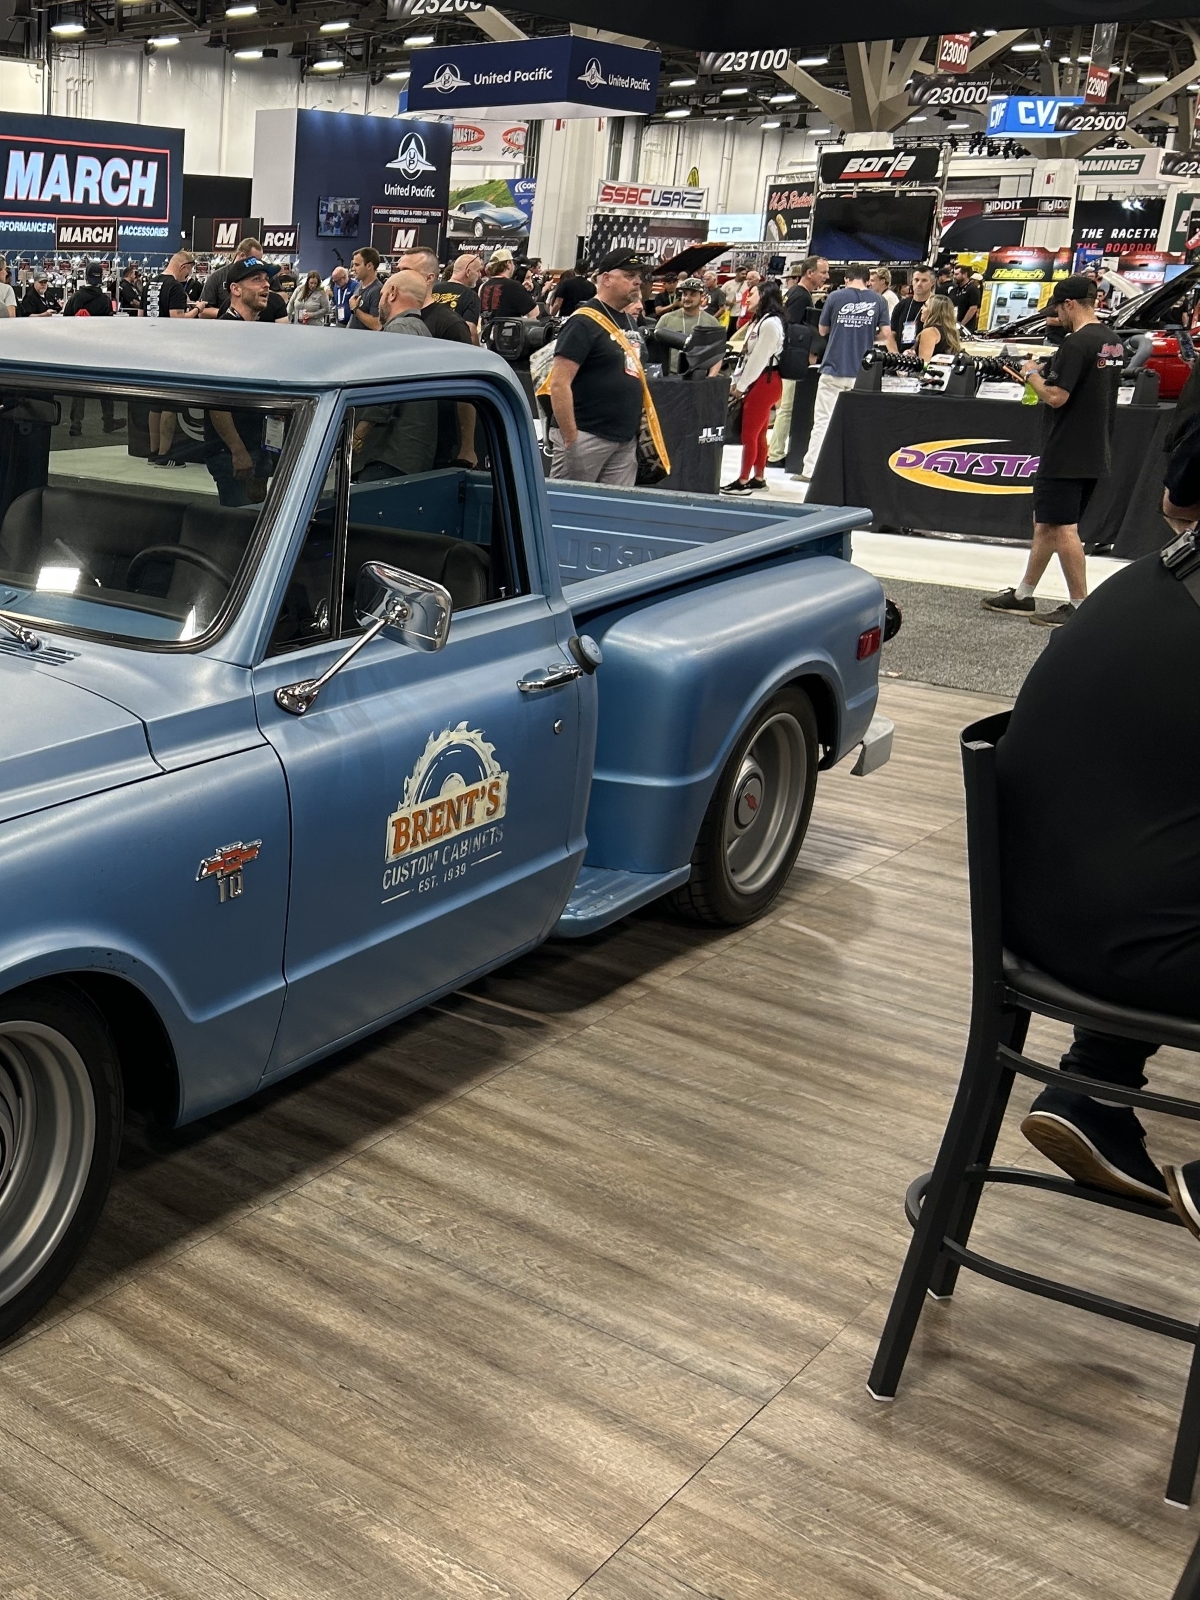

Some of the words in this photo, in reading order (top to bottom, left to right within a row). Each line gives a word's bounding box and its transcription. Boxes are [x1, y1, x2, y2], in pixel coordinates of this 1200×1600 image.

[720, 48, 788, 72] 23100
[941, 40, 968, 65] 23000
[474, 70, 512, 86] United
[514, 67, 553, 82] Pacific
[608, 74, 630, 88] United
[630, 78, 650, 91] Pacific
[928, 86, 988, 105] 23000
[1087, 76, 1108, 98] 22900
[990, 102, 1007, 128] CVF
[1072, 115, 1126, 131] 22900
[1079, 160, 1140, 171] MMINGS
[4, 150, 158, 208] MARCH
[384, 184, 410, 196] United
[411, 185, 435, 198] Pacific
[59, 226, 114, 243] MARCH
[124, 226, 168, 236] ACCESSORIES
[216, 223, 238, 244] M
[264, 232, 295, 247] RCH
[394, 229, 416, 248] M
[1082, 229, 1104, 238] THE
[1110, 229, 1158, 238] RACETR
[1105, 243, 1157, 253] BOARDR
[699, 426, 725, 438] JLT
[894, 447, 1040, 478] DAYSTA
[392, 781, 500, 855] BRENT'S
[383, 850, 439, 890] CUSTOM
[442, 824, 504, 865] CABINETS
[418, 876, 438, 893] EST.
[443, 863, 466, 882] 1939
